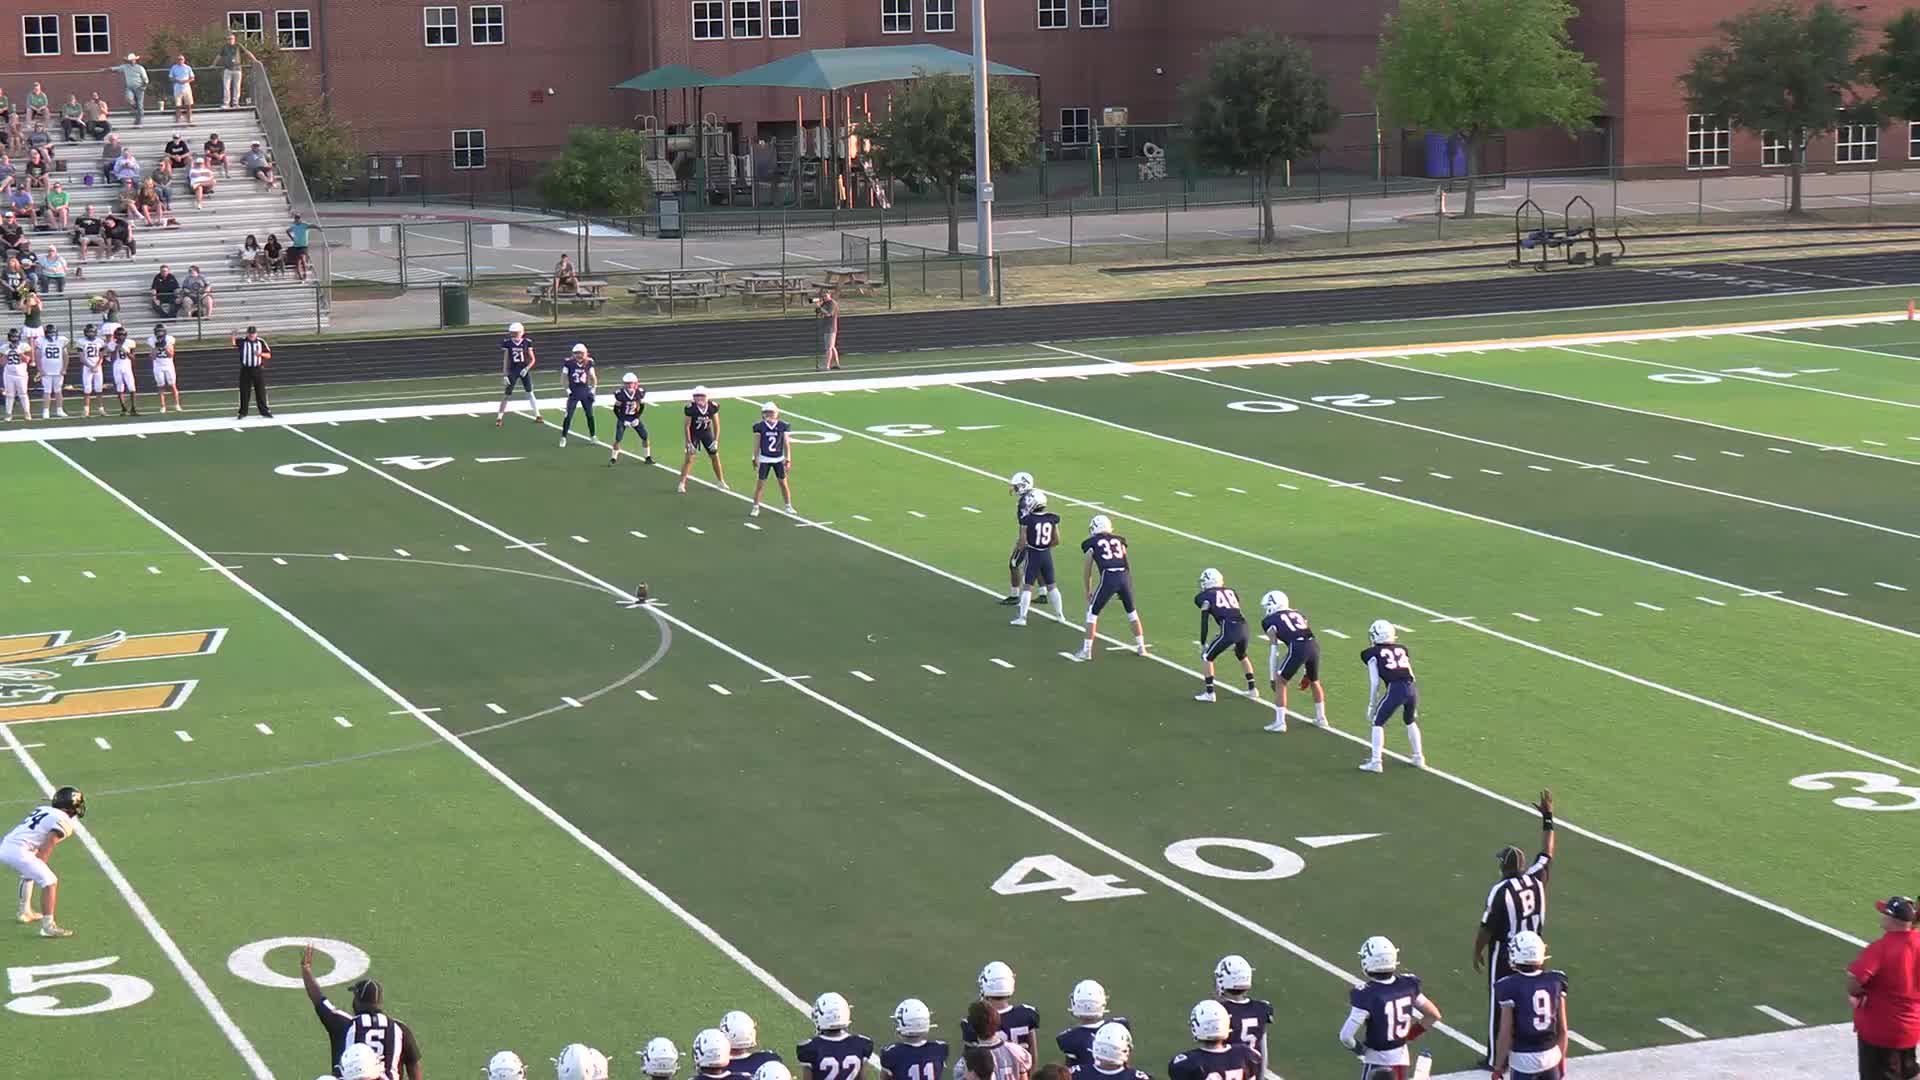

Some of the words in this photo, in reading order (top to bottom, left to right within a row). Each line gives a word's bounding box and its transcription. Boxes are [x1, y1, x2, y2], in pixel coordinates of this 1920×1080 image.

[45, 346, 60, 360] 62
[511, 351, 525, 363] 21
[768, 436, 777, 452] 2
[1035, 521, 1052, 546] 19
[1097, 538, 1125, 560] 33
[1280, 611, 1309, 632] 13
[1380, 647, 1410, 670] 32
[1384, 996, 1412, 1042] 15
[1532, 988, 1552, 1032] 9
[1240, 1017, 1259, 1049] 5
